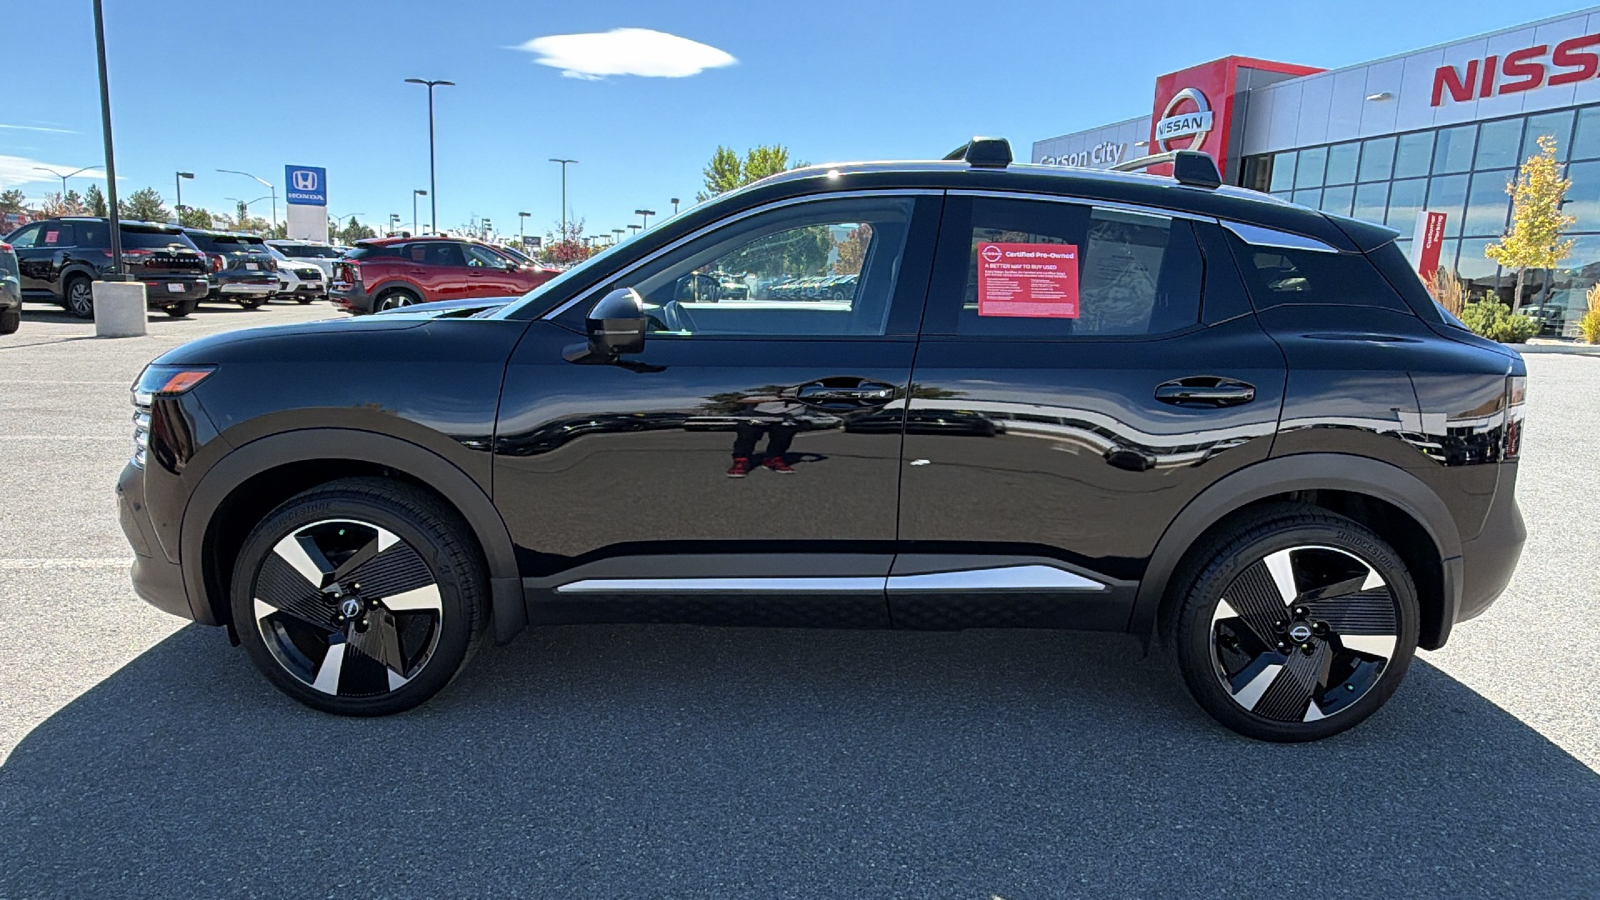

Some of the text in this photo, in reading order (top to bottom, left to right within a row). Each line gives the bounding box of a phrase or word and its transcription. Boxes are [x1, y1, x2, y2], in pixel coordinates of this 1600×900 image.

[1430, 33, 1600, 107] NISS
[1158, 115, 1204, 136] NISSAN
[1040, 141, 1124, 166] Carson City
[287, 193, 324, 201] HONDA
[1426, 215, 1436, 249] Customer
[1433, 215, 1444, 243] Parking
[1005, 251, 1035, 259] Certified
